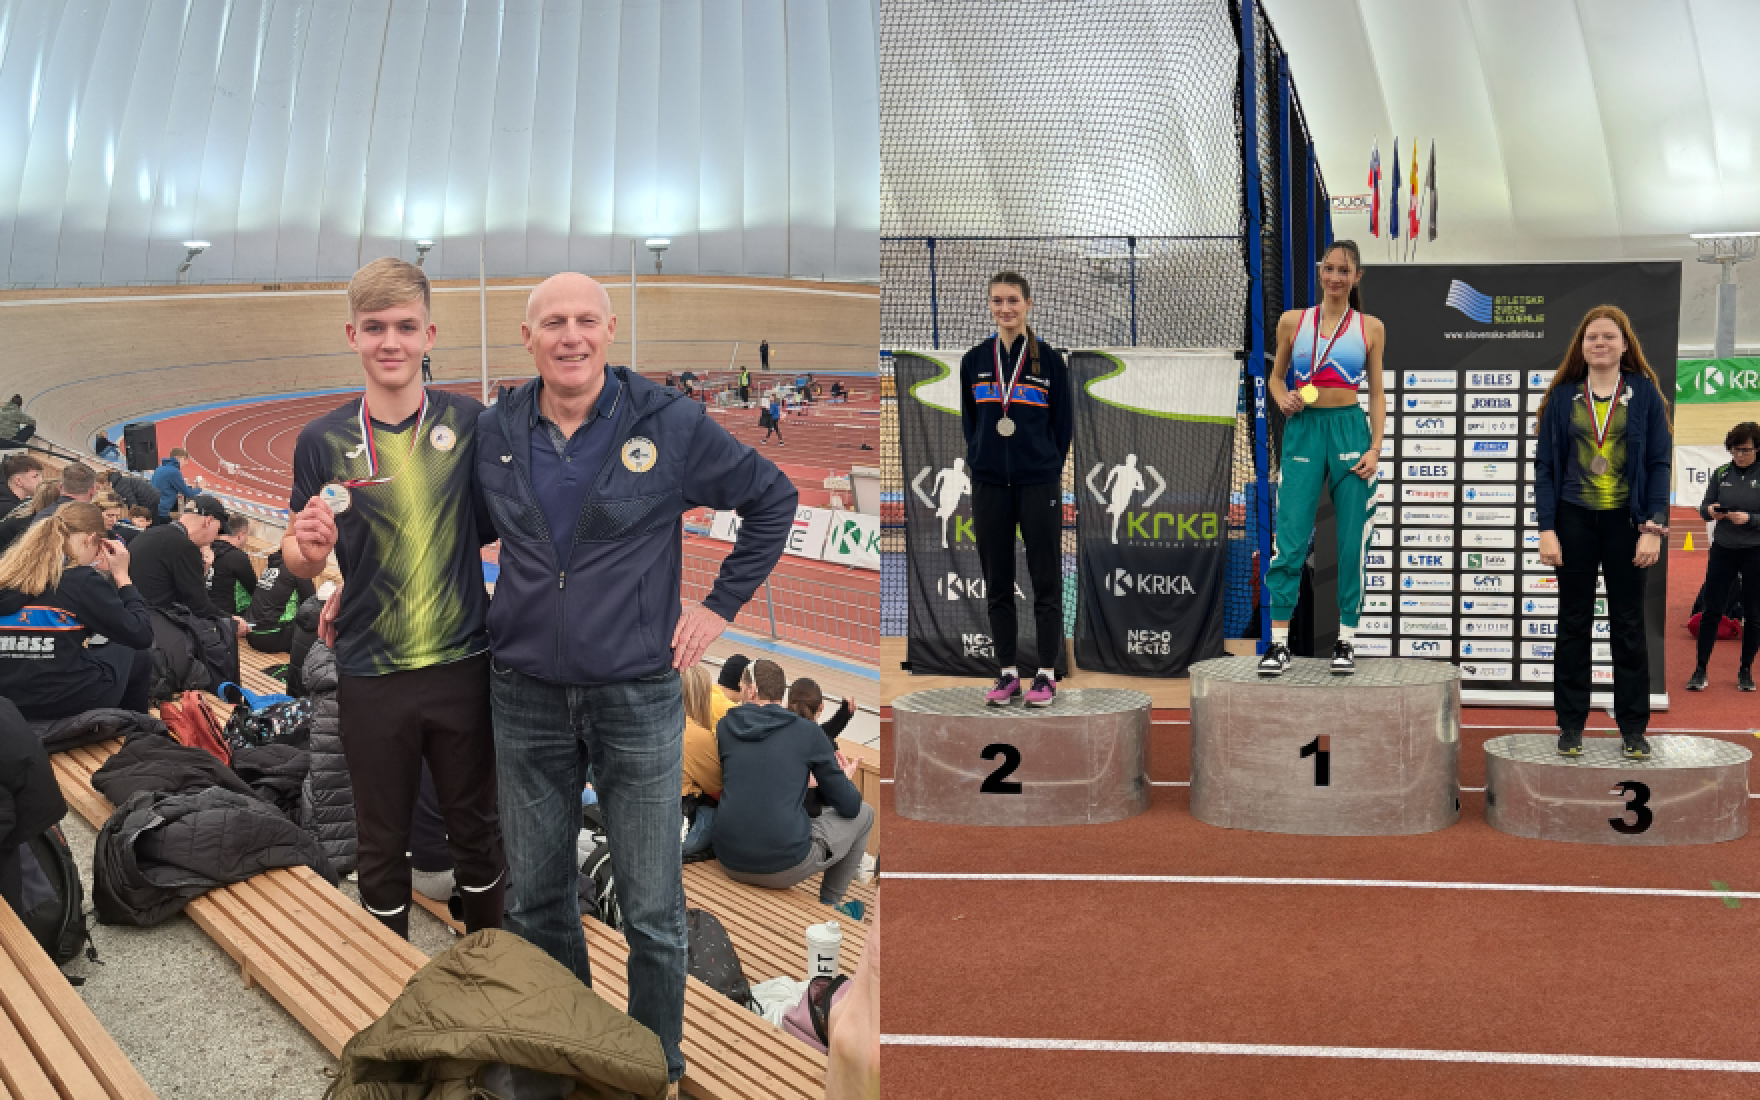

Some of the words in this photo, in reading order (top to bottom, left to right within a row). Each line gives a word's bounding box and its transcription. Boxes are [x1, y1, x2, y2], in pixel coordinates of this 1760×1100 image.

[1483, 374, 1513, 387] ELES
[1419, 465, 1449, 477] ELES
[1137, 573, 1197, 595] KRKA
[979, 742, 1023, 795] 2
[1299, 733, 1331, 787] 1
[1608, 779, 1654, 835] 3
